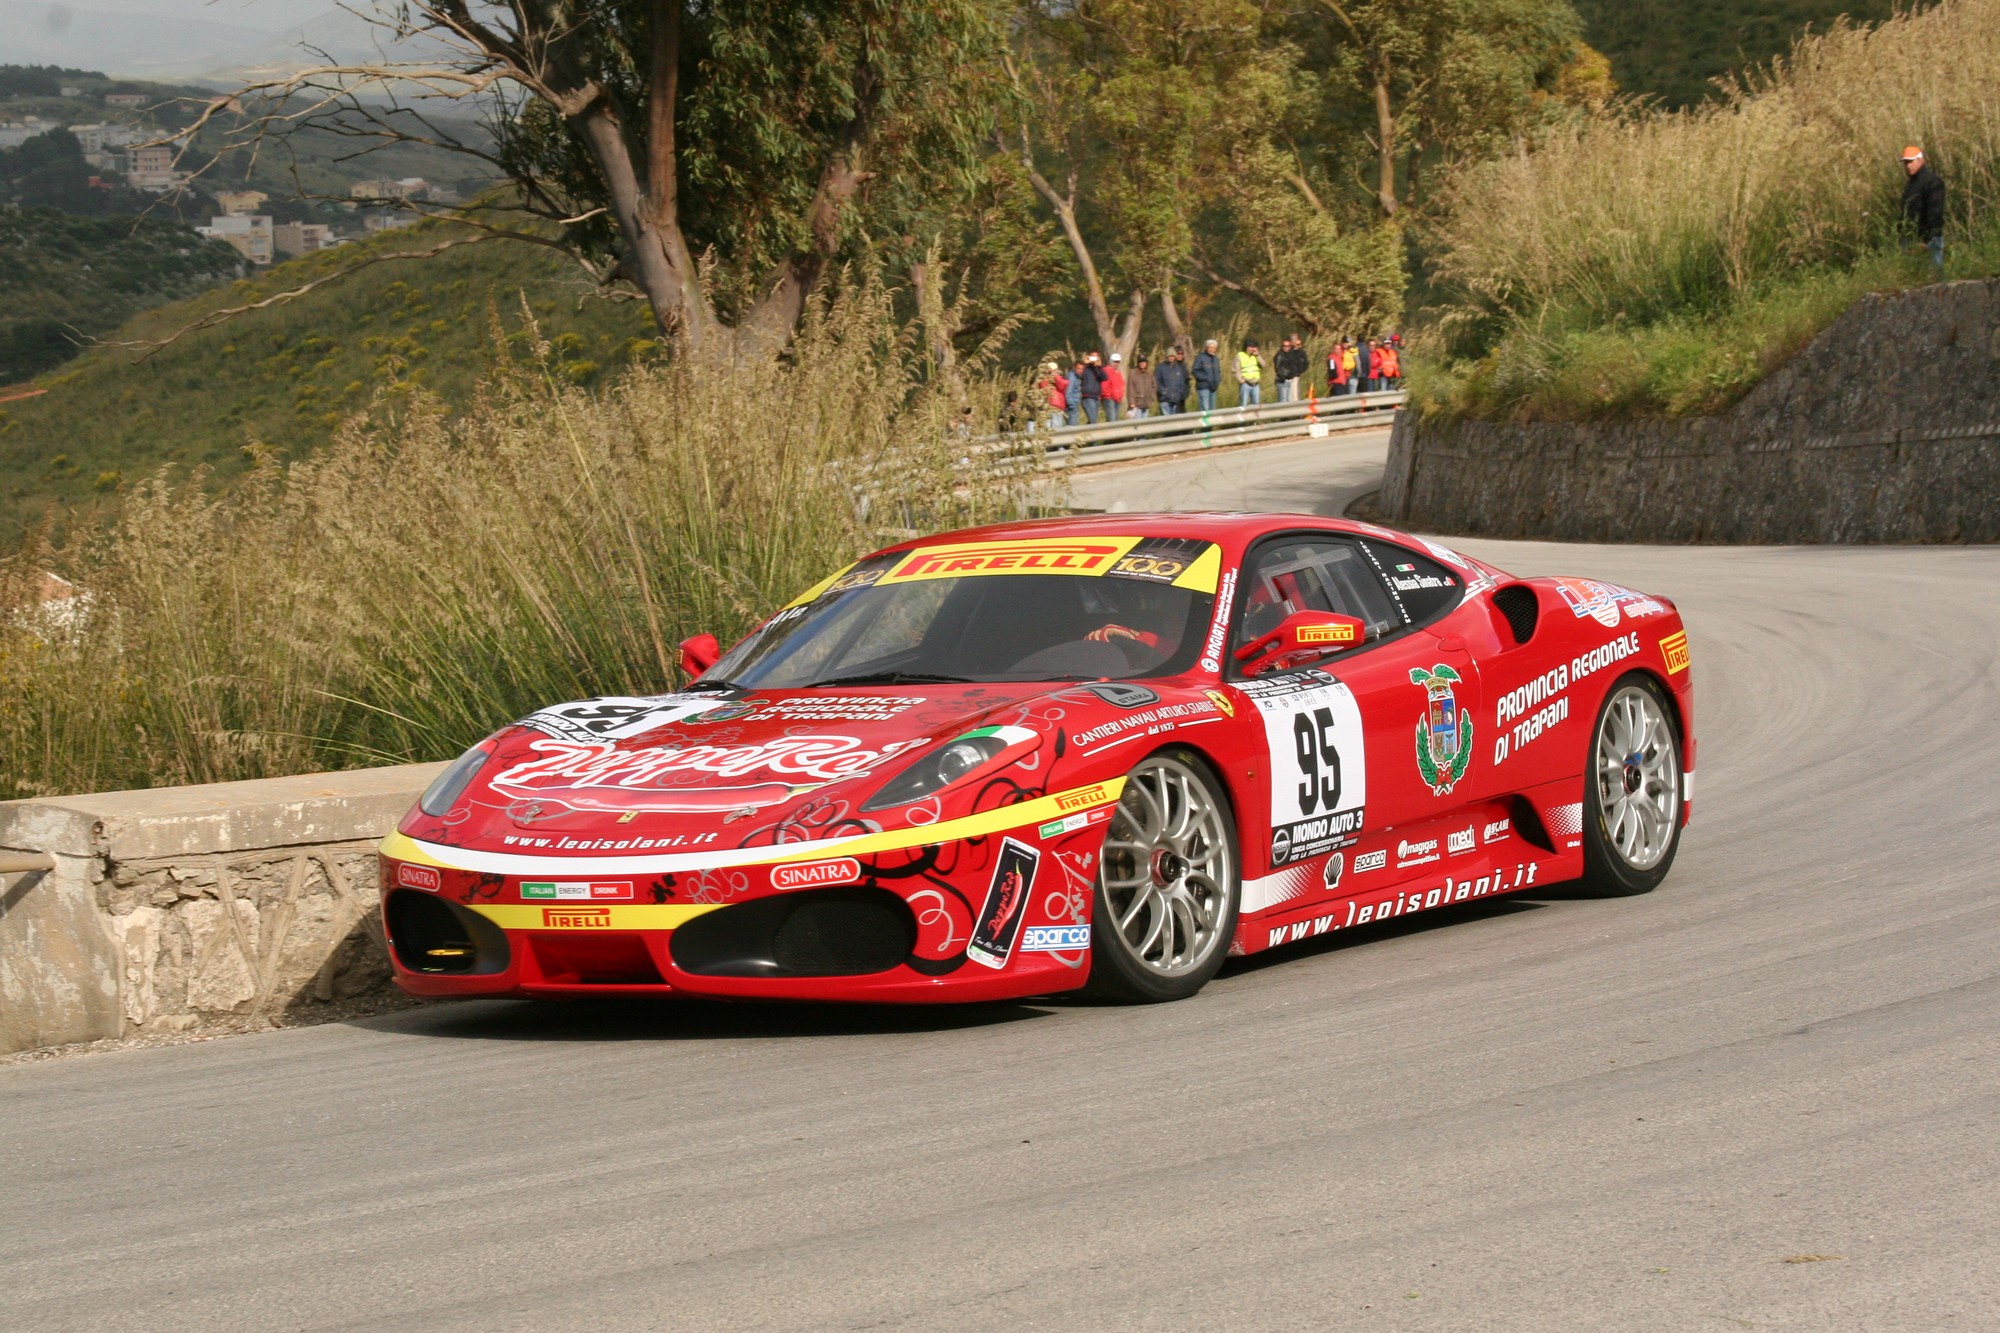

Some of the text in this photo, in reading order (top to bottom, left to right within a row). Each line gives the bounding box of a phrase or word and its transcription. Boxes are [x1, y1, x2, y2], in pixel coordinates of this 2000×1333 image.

[893, 545, 1119, 578] PIRELLI
[1116, 557, 1183, 576] 100
[1299, 627, 1352, 641] PIRELLI
[1497, 631, 1640, 728] PROVINCIA REGIONALE
[776, 697, 927, 706] PROVINCIA
[1118, 693, 1150, 704] STAMA
[743, 713, 895, 721] DI TRAPANI
[760, 704, 912, 713] REGIONALE
[1072, 700, 1217, 747] CANTIERI NAVALI ARTURO STABILE
[1148, 725, 1159, 736] dal
[1494, 696, 1569, 766] DI TRAPANI
[1293, 707, 1342, 816] 95
[1055, 785, 1107, 811] PIRELLI
[1043, 824, 1064, 835] ITALIAN
[1066, 817, 1085, 828] ENERGY
[1292, 810, 1364, 844] MONDO AUTO 3
[503, 832, 719, 850] www.leoisolani.it
[1407, 839, 1438, 855] magigas
[1356, 852, 1385, 868] sparco
[401, 868, 436, 886] SINATRA
[780, 863, 852, 885] SINATRA
[529, 886, 618, 895] ITALIAN ENERGY DRINK
[1269, 862, 1539, 948] www.leoisolani.it
[542, 907, 611, 927] PIRELLI
[1023, 927, 1089, 949] sparco
